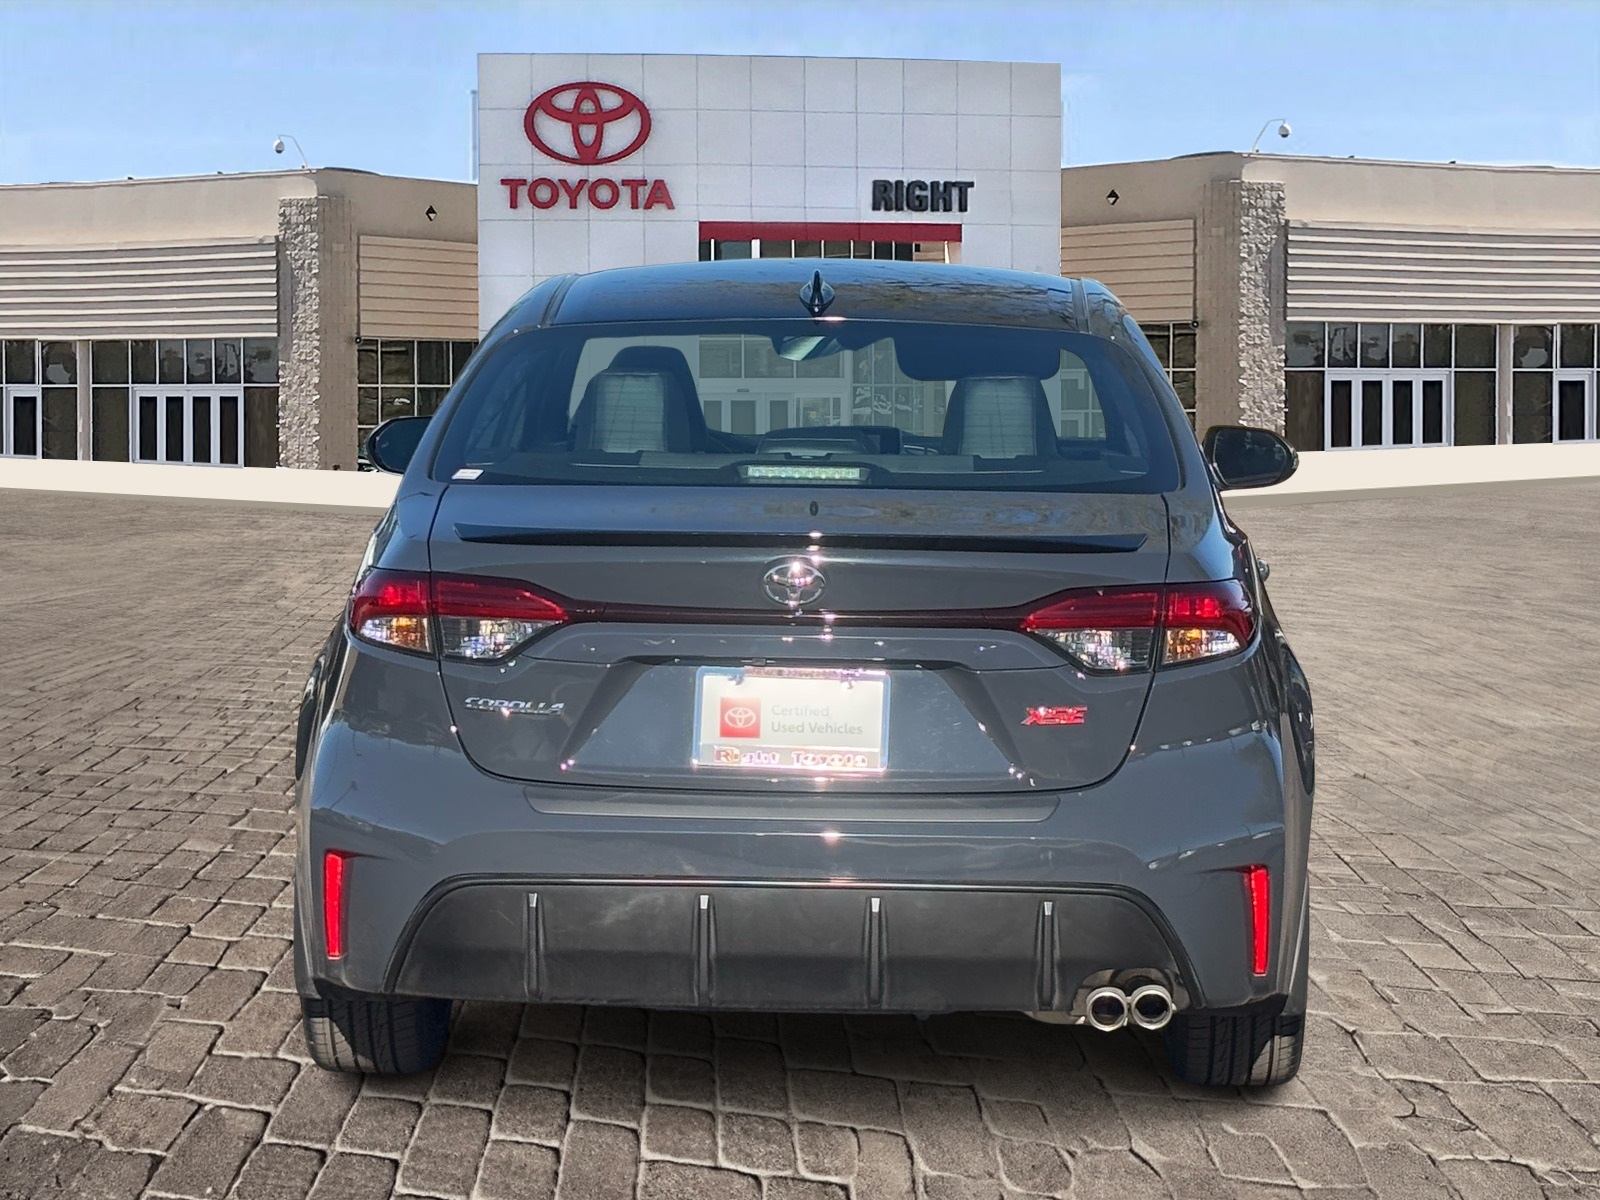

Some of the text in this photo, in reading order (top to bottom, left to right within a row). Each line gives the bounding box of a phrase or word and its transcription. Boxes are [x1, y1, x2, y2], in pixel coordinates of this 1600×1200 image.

[500, 178, 676, 210] TOYOTA
[871, 180, 975, 212] RIGHT
[464, 696, 565, 715] COROLLA
[771, 704, 830, 717] Certified
[1021, 705, 1088, 726] XSE
[771, 721, 863, 735] Used Vehicles
